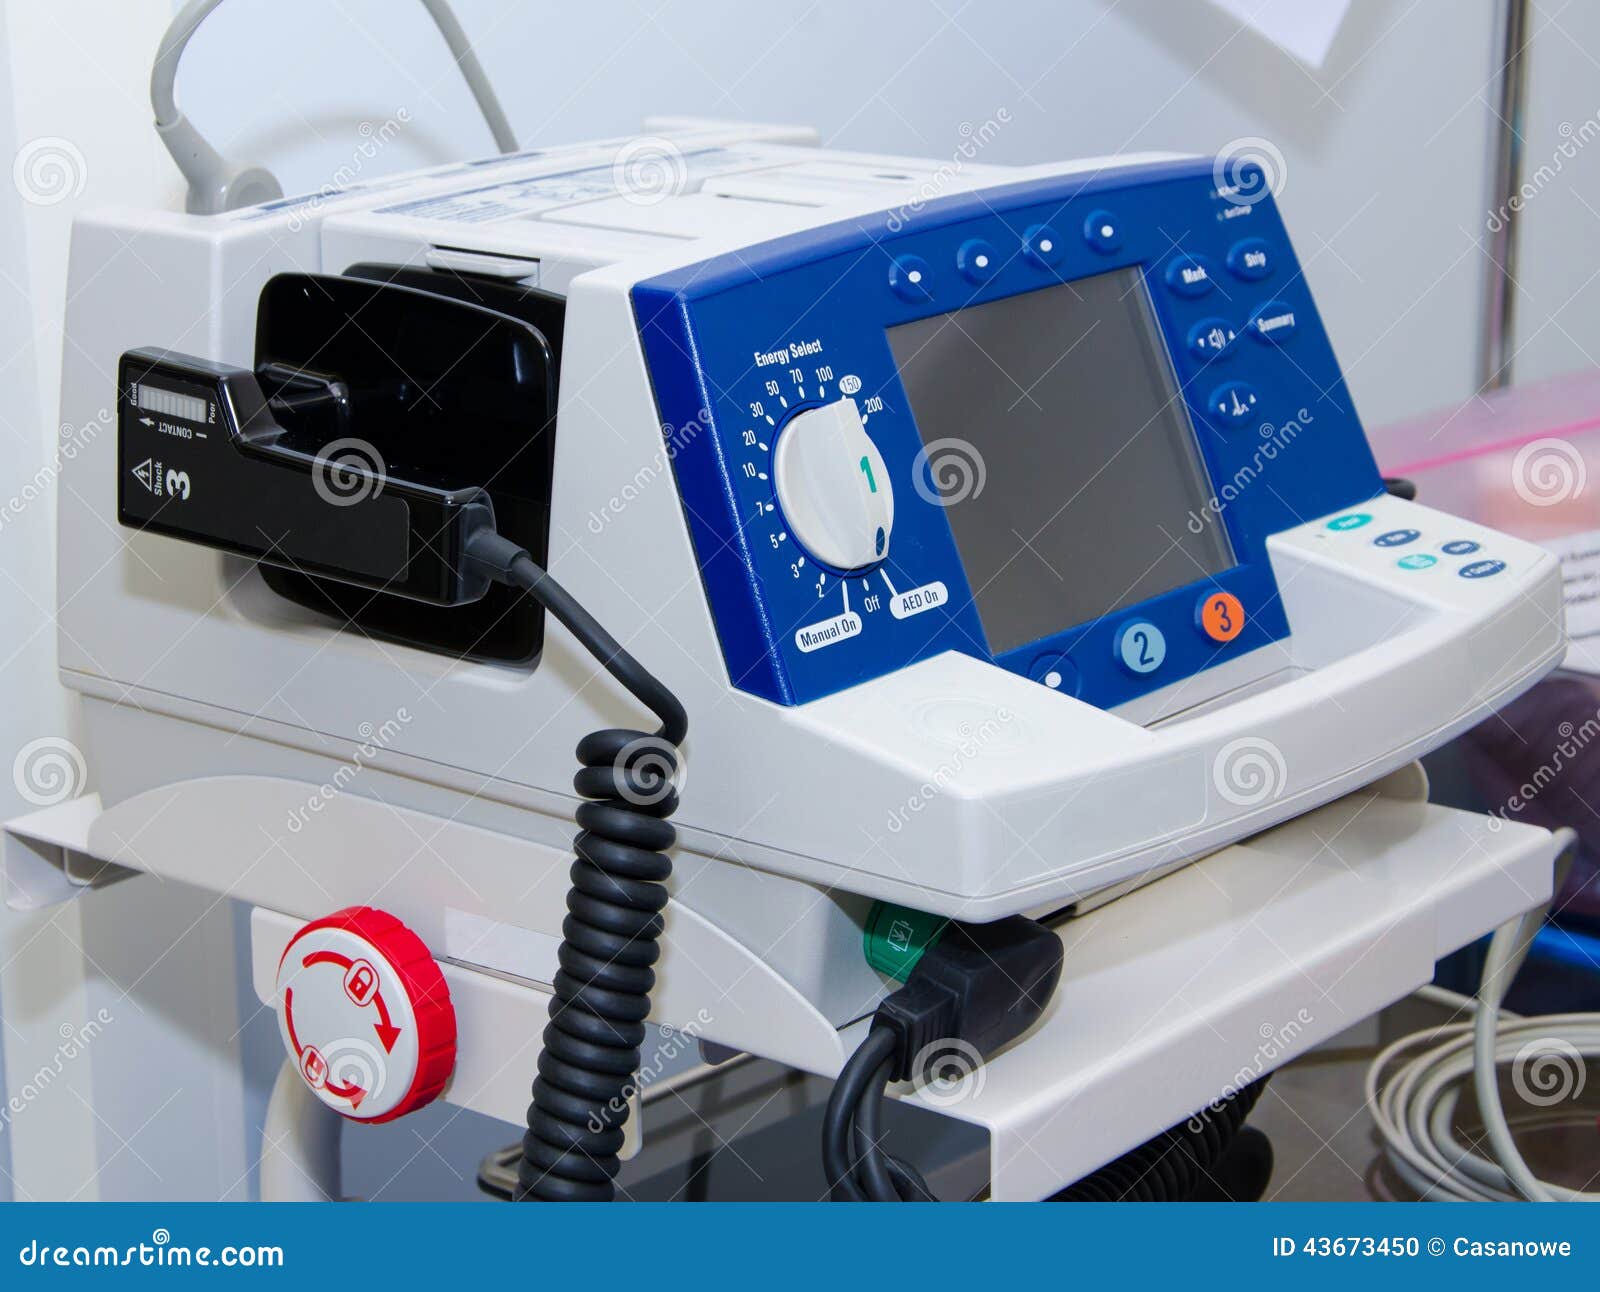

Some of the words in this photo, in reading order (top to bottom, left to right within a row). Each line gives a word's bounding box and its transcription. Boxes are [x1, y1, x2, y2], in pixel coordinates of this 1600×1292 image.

[754, 346, 789, 368] Energy
[789, 339, 823, 358] Select
[789, 368, 804, 384] 70
[815, 366, 834, 382] 100
[765, 381, 780, 397] 50
[842, 377, 860, 392] 150
[208, 402, 216, 424] Poor
[750, 402, 764, 417] 30
[864, 397, 884, 413] 200
[158, 421, 193, 440] CONTACT
[742, 430, 756, 445] 20
[742, 463, 756, 478] 10
[860, 456, 877, 493] 1
[154, 462, 163, 496] Shock
[166, 469, 191, 500] 3
[756, 502, 764, 516] 7
[770, 534, 779, 549] 5
[791, 564, 800, 578] 3
[816, 583, 825, 598] 2
[864, 596, 881, 613] Off
[902, 593, 924, 612] AED
[925, 589, 939, 605] On
[1214, 600, 1232, 633] 3
[800, 620, 841, 648] Manual
[841, 618, 857, 633] On
[1134, 631, 1154, 666] 2
